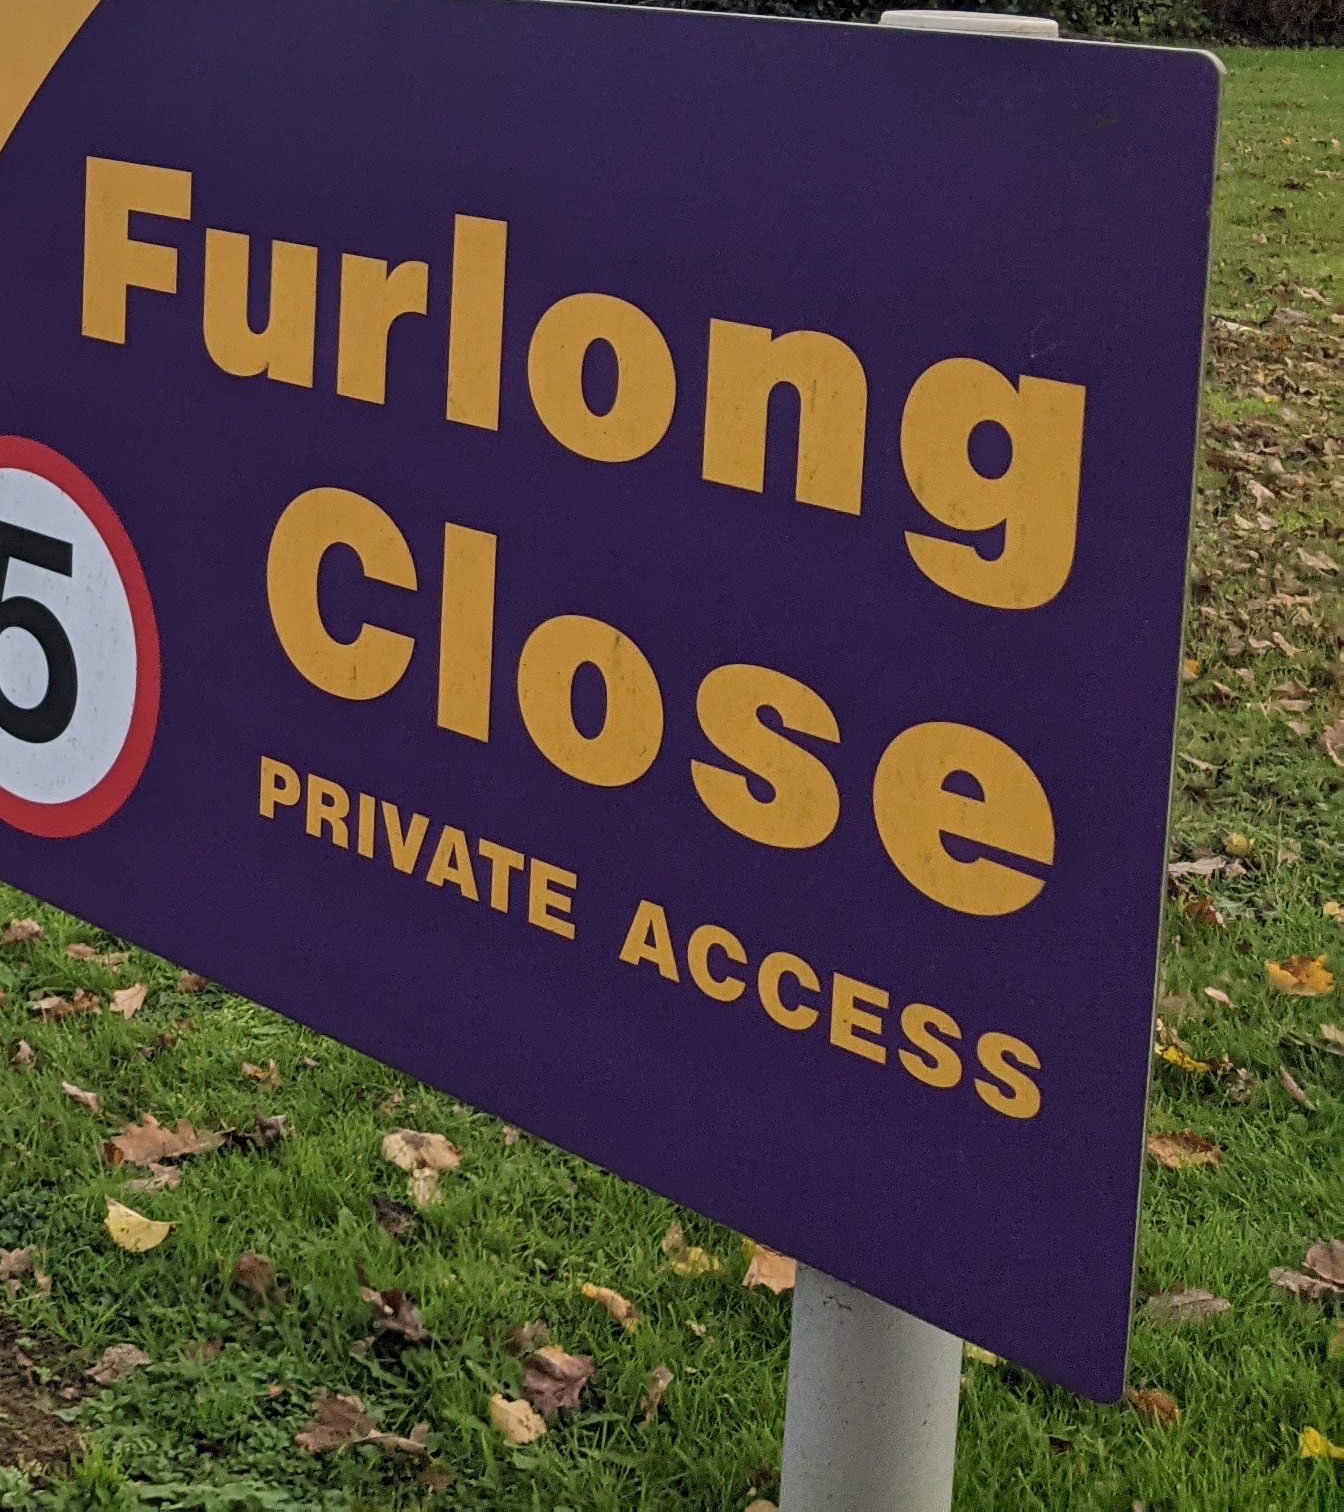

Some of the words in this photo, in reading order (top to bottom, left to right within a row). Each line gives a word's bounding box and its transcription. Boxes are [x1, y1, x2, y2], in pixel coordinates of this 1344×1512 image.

[81, 155, 1087, 610] Furlong
[266, 487, 1056, 917] Close
[259, 756, 578, 940] PRIVATE
[619, 900, 1042, 1120] ACCESS
